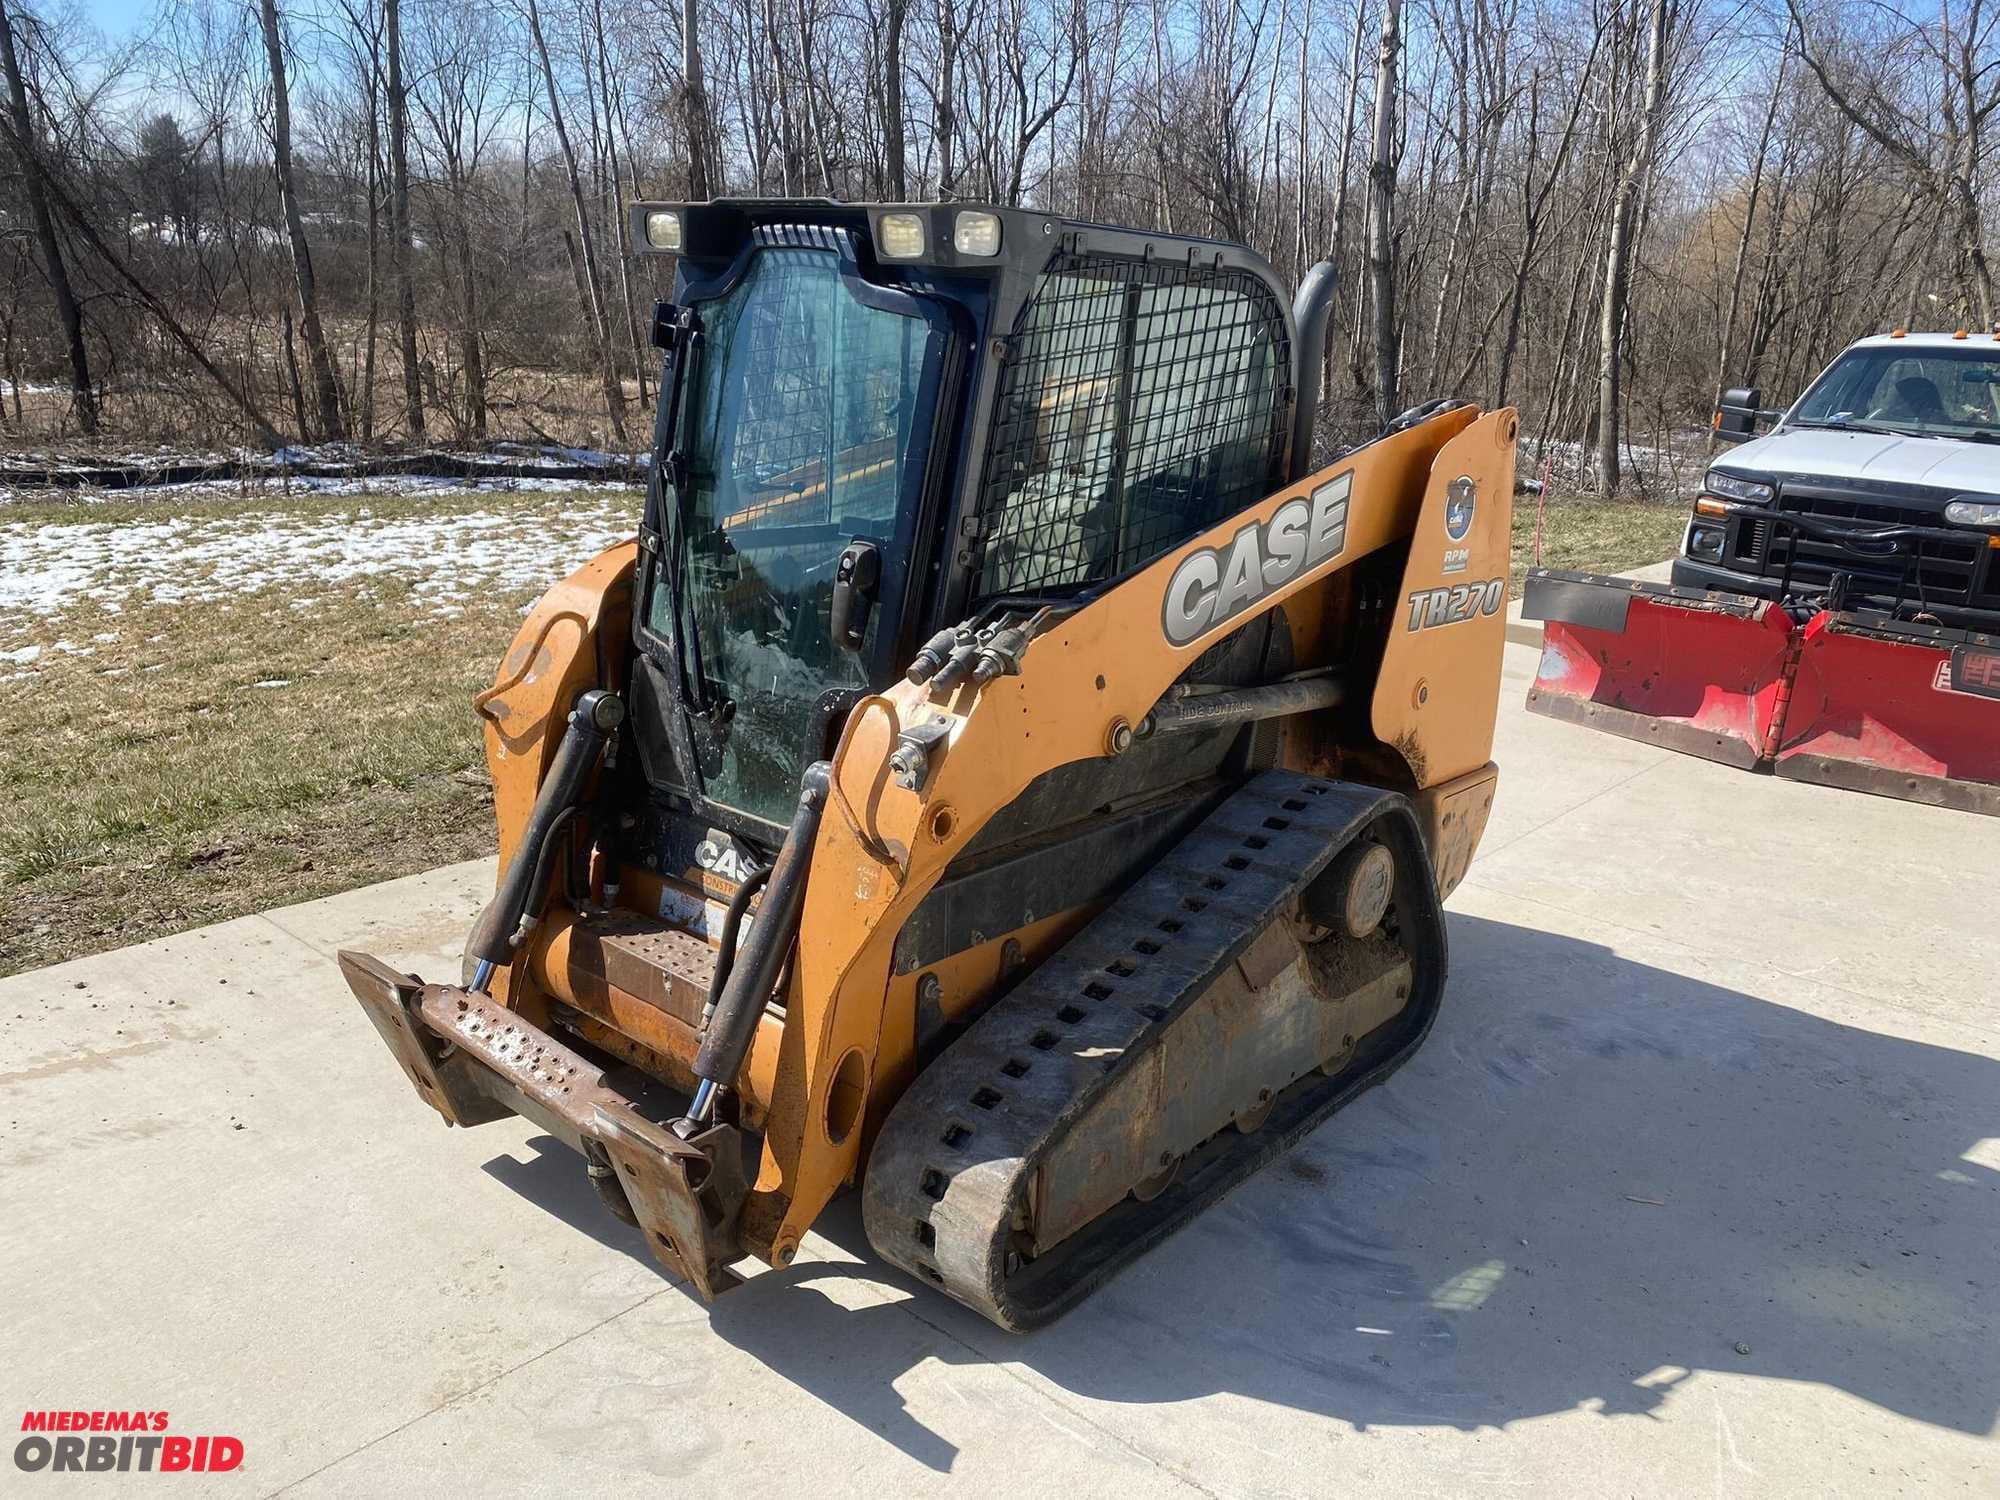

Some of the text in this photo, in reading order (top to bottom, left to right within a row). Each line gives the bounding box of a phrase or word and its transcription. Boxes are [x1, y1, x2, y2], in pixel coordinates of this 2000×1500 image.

[1163, 469, 1353, 646] CASE
[1444, 548, 1470, 562] RPM
[1408, 577, 1504, 631] TR270
[695, 840, 768, 883] CAS
